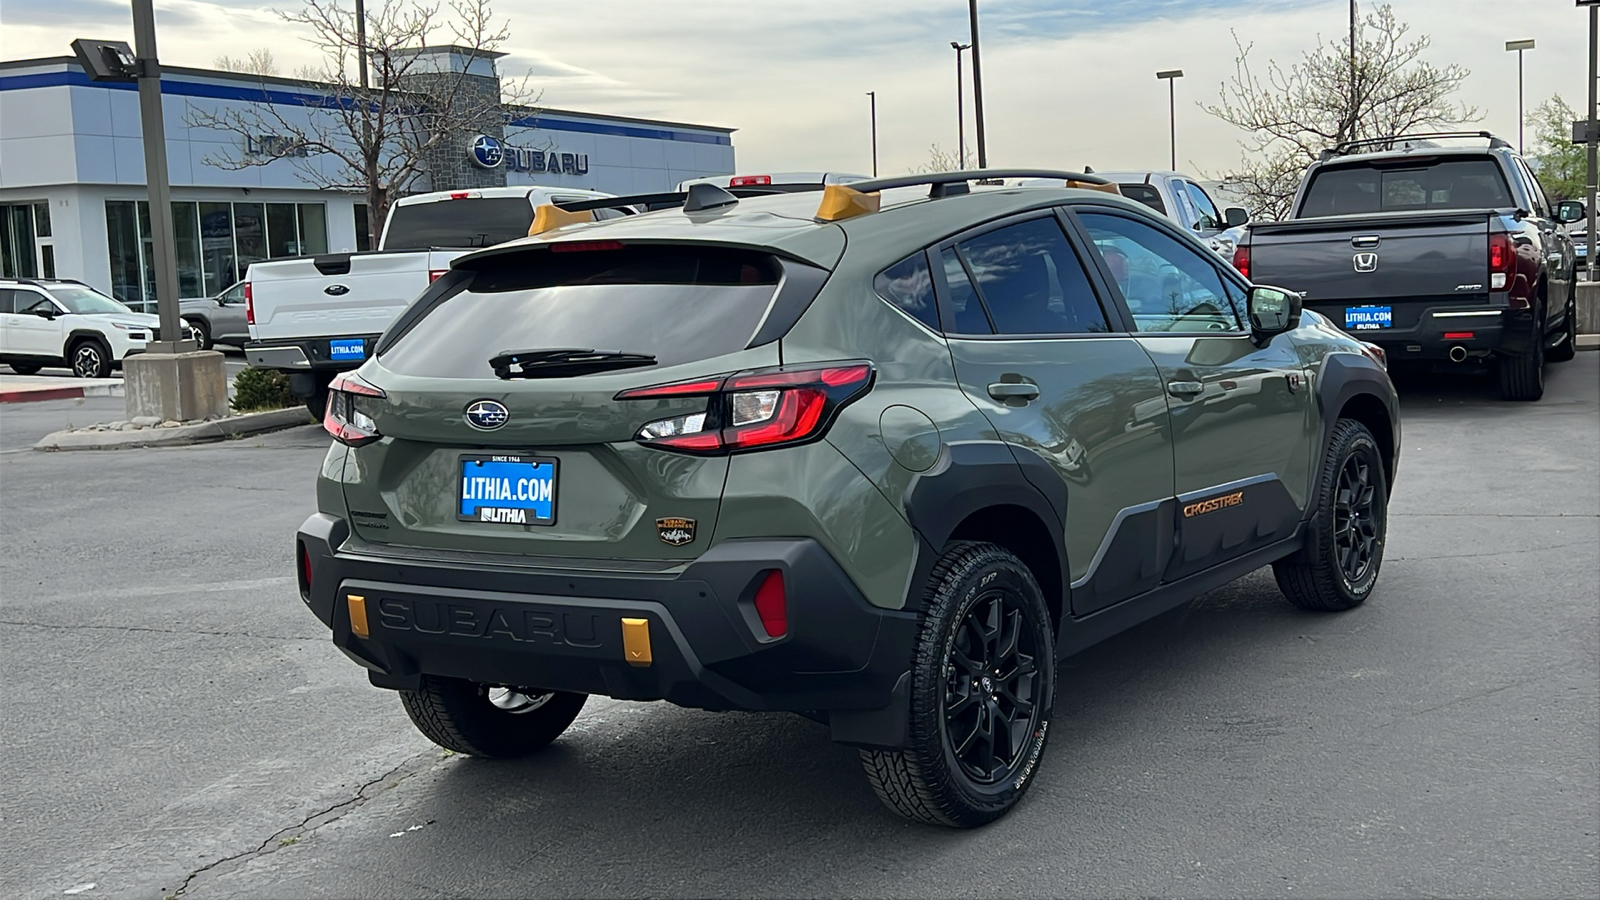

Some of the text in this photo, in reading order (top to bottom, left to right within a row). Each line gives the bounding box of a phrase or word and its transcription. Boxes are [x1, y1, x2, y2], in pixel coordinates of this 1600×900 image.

[504, 148, 589, 175] SUBARU
[1345, 312, 1392, 323] LITHIA.COM
[331, 345, 364, 355] LITHIA.COM
[462, 477, 553, 502] LITHIA.COM
[491, 507, 526, 523] LITHIA
[1183, 491, 1244, 518] CROSSTREK
[378, 598, 603, 648] SUBARU
